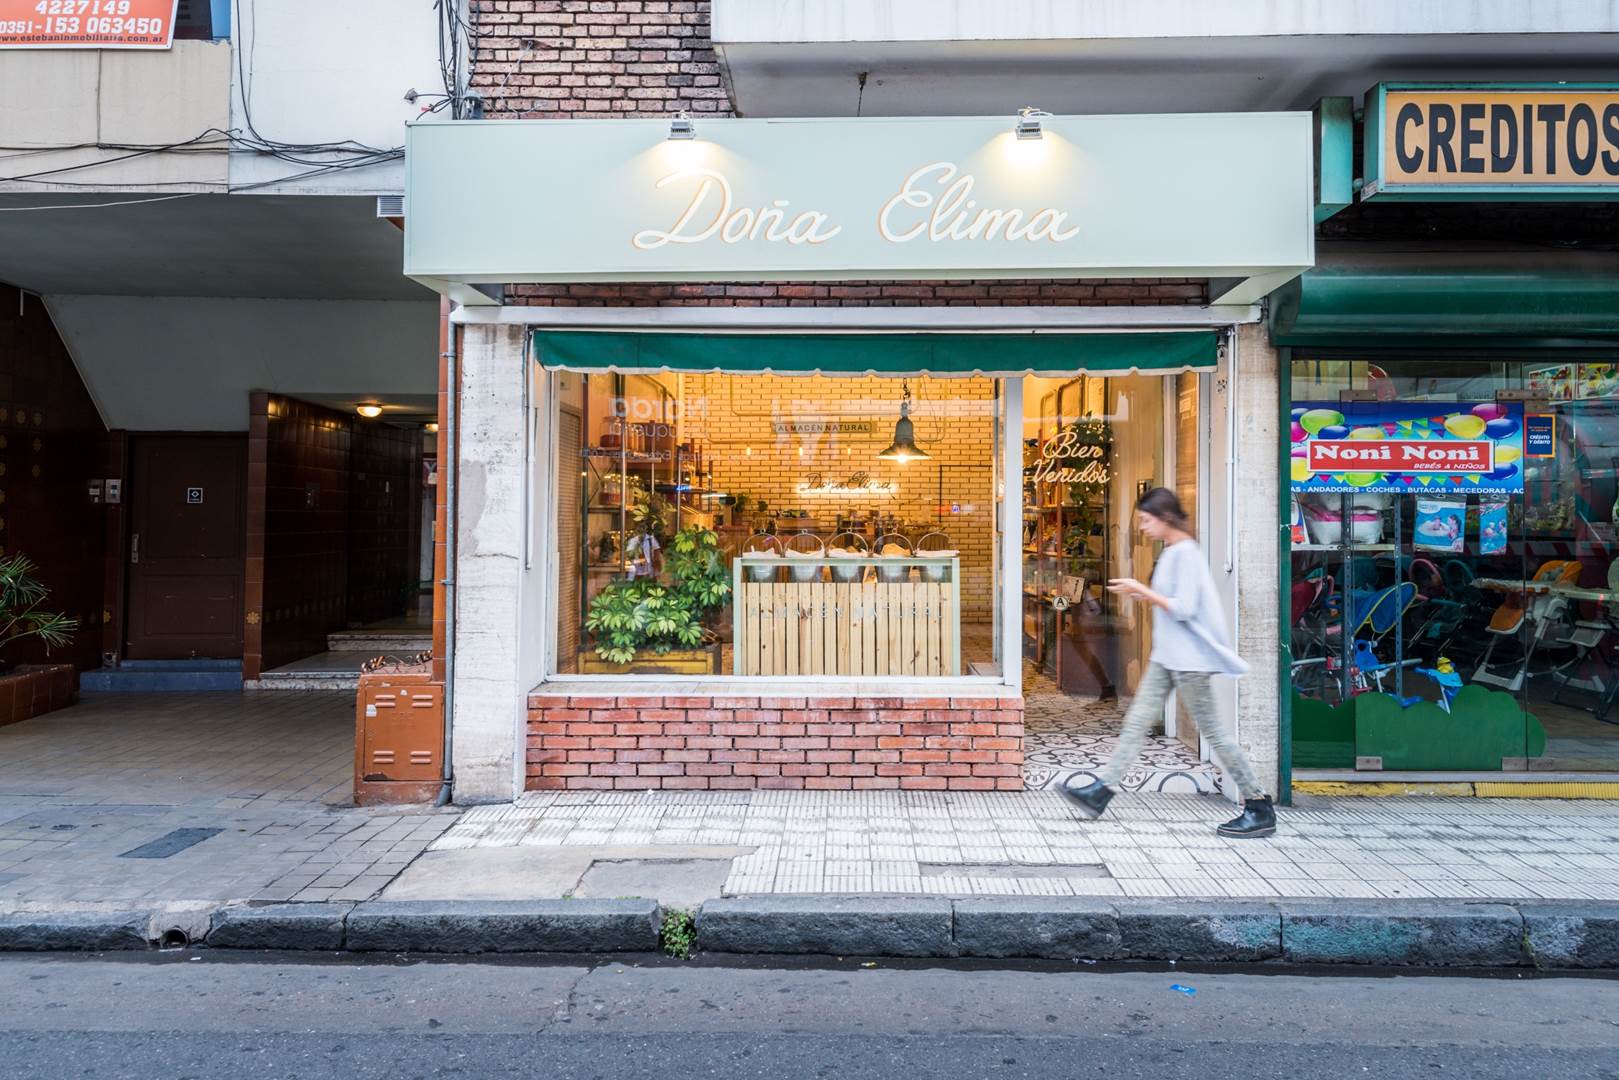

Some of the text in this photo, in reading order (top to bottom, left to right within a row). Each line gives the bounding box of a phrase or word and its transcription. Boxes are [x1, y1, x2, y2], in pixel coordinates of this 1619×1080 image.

[35, 0, 130, 15] 4227149
[86, 16, 162, 35] 063450
[0, 34, 163, 42] ww.estebaninmobiliaria.com.ar
[1395, 102, 1619, 176] CREDITOS
[632, 162, 1080, 250] Doña Elima
[825, 423, 869, 431] NATURAL
[1043, 432, 1103, 458] Bien
[1314, 445, 1480, 460] Noni Noni
[1033, 457, 1111, 483] Venidos
